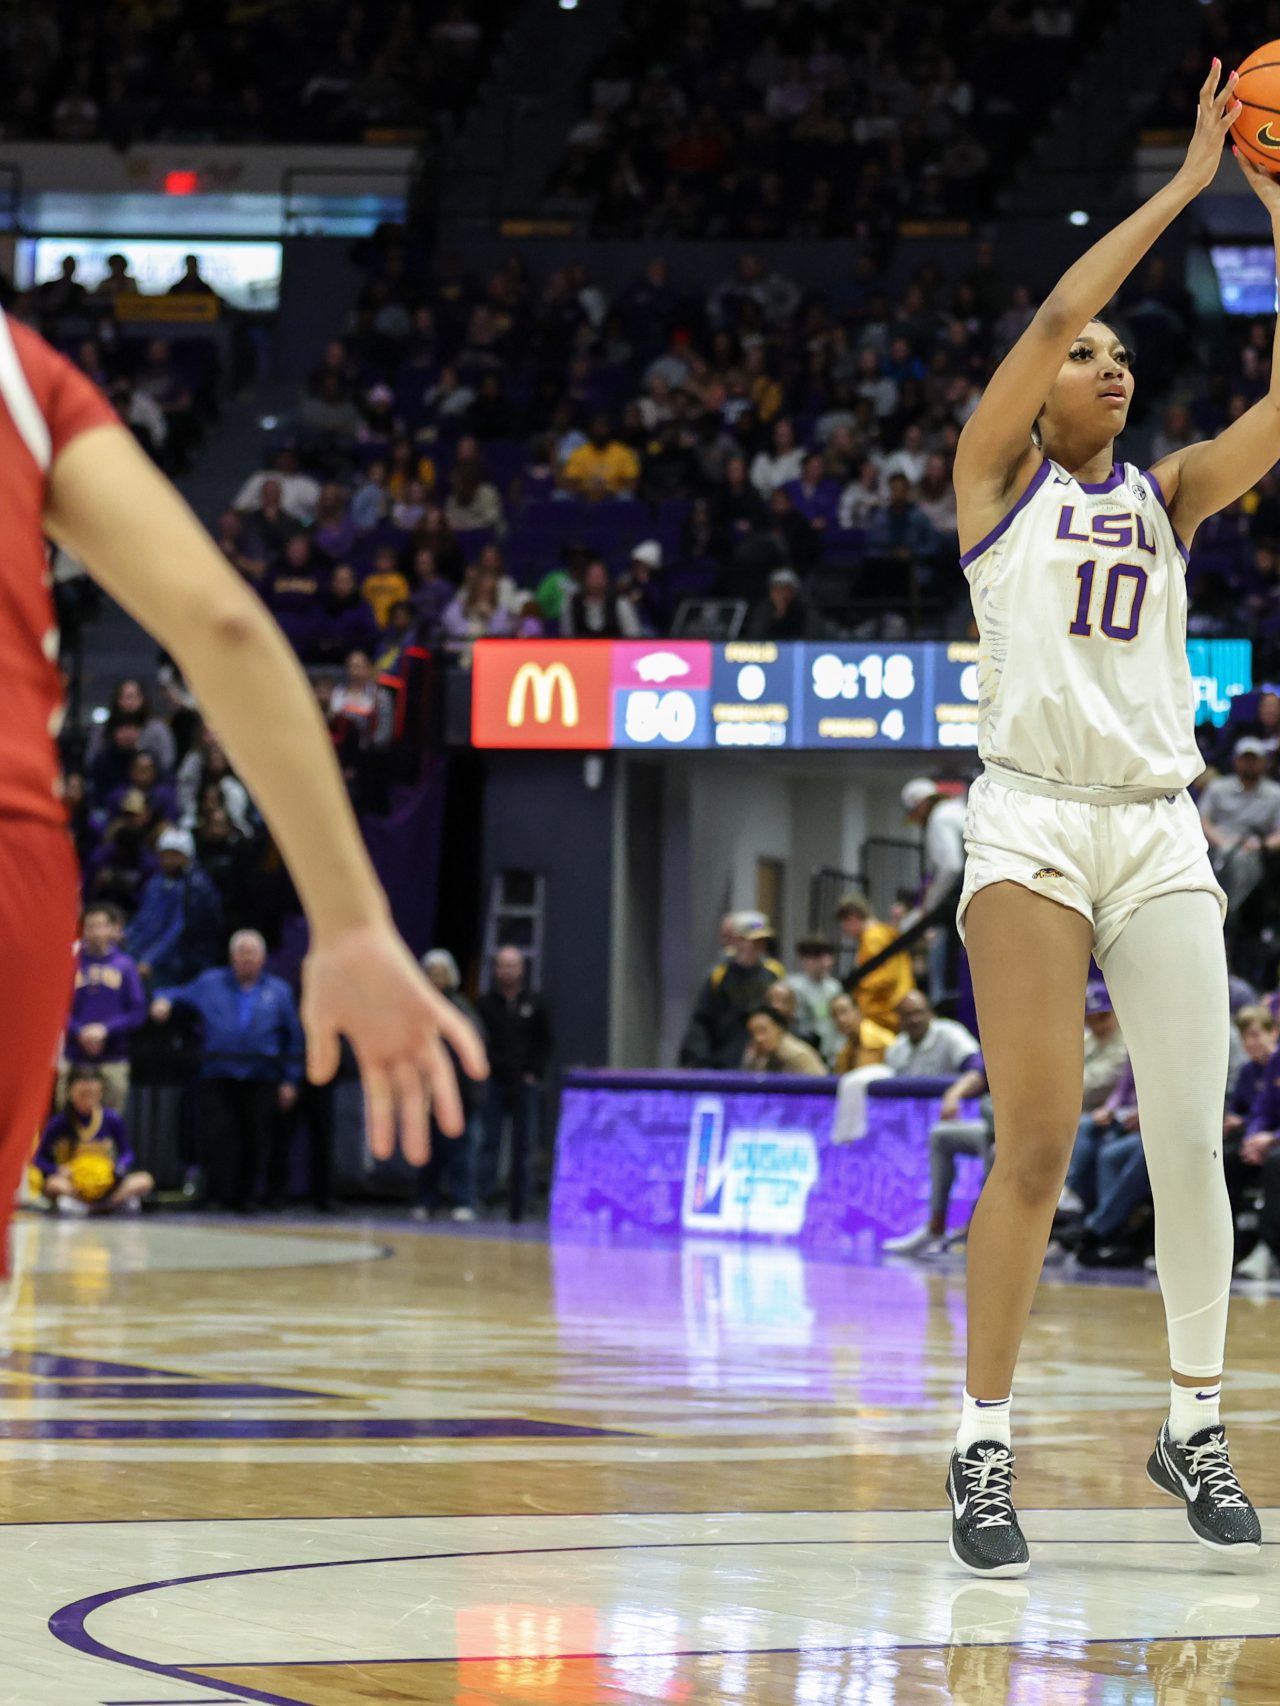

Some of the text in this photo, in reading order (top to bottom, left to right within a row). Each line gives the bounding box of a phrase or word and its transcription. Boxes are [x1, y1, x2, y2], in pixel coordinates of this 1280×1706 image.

[1055, 504, 1157, 556] LSU
[1068, 559, 1149, 643] 10
[812, 653, 915, 699] 9:18
[625, 690, 696, 743] 50
[881, 709, 905, 741] 4
